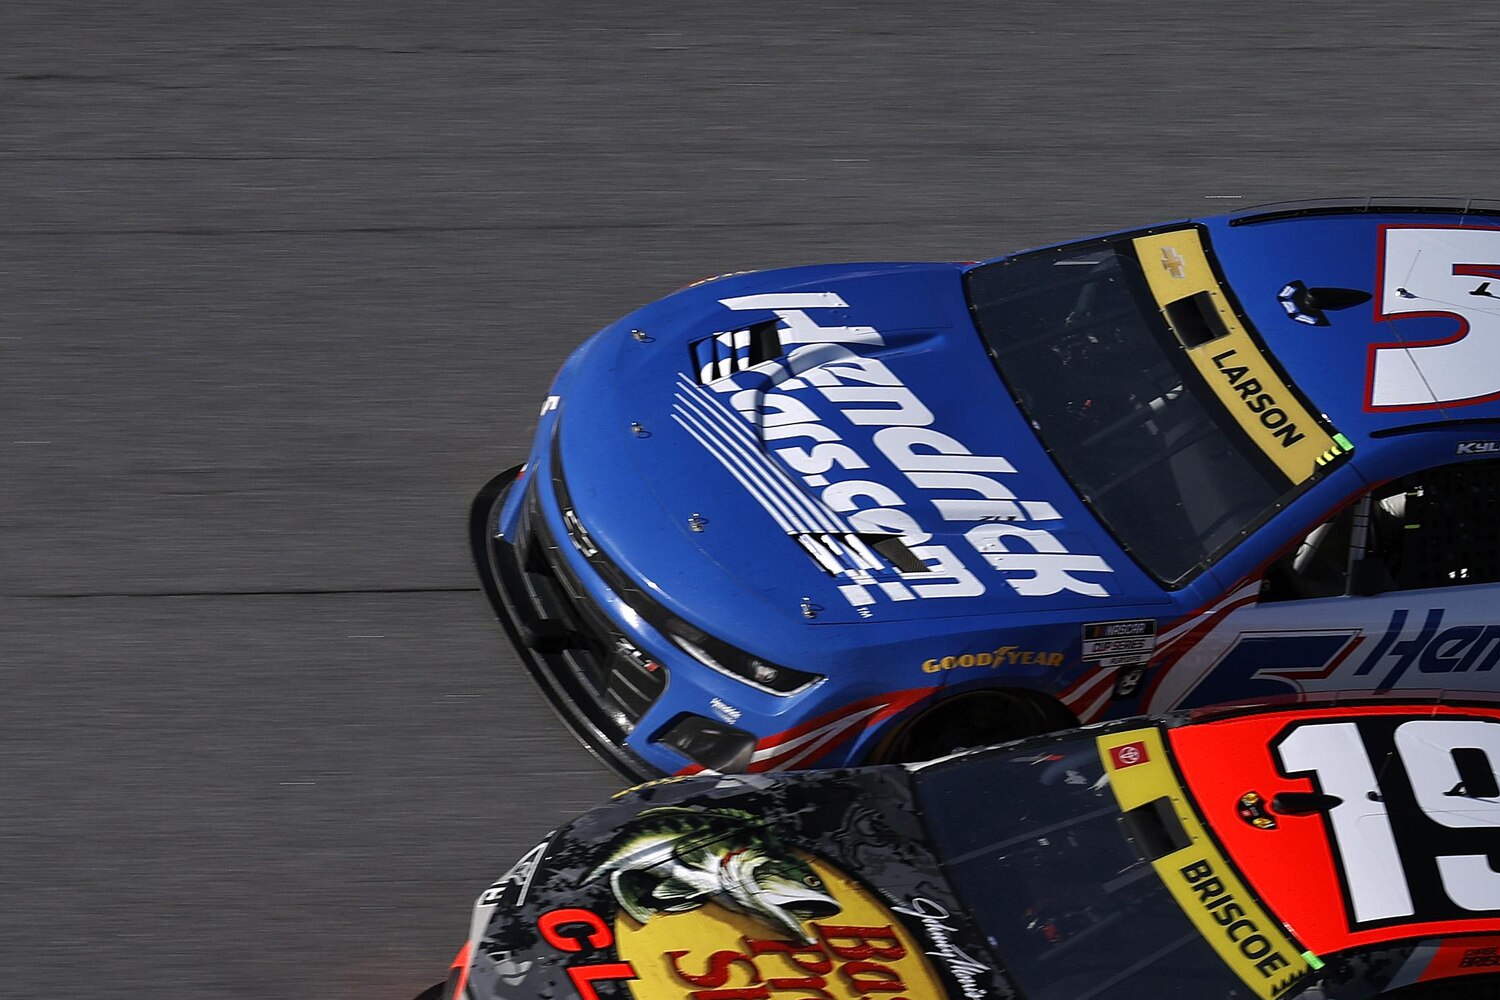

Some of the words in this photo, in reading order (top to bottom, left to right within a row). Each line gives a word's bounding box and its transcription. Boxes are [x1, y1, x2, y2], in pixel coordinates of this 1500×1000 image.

[718, 292, 1114, 598] Hendrick
[1211, 349, 1305, 448] LARSON
[922, 646, 1064, 674] GOODYEAR
[1179, 858, 1291, 979] BRISCOE
